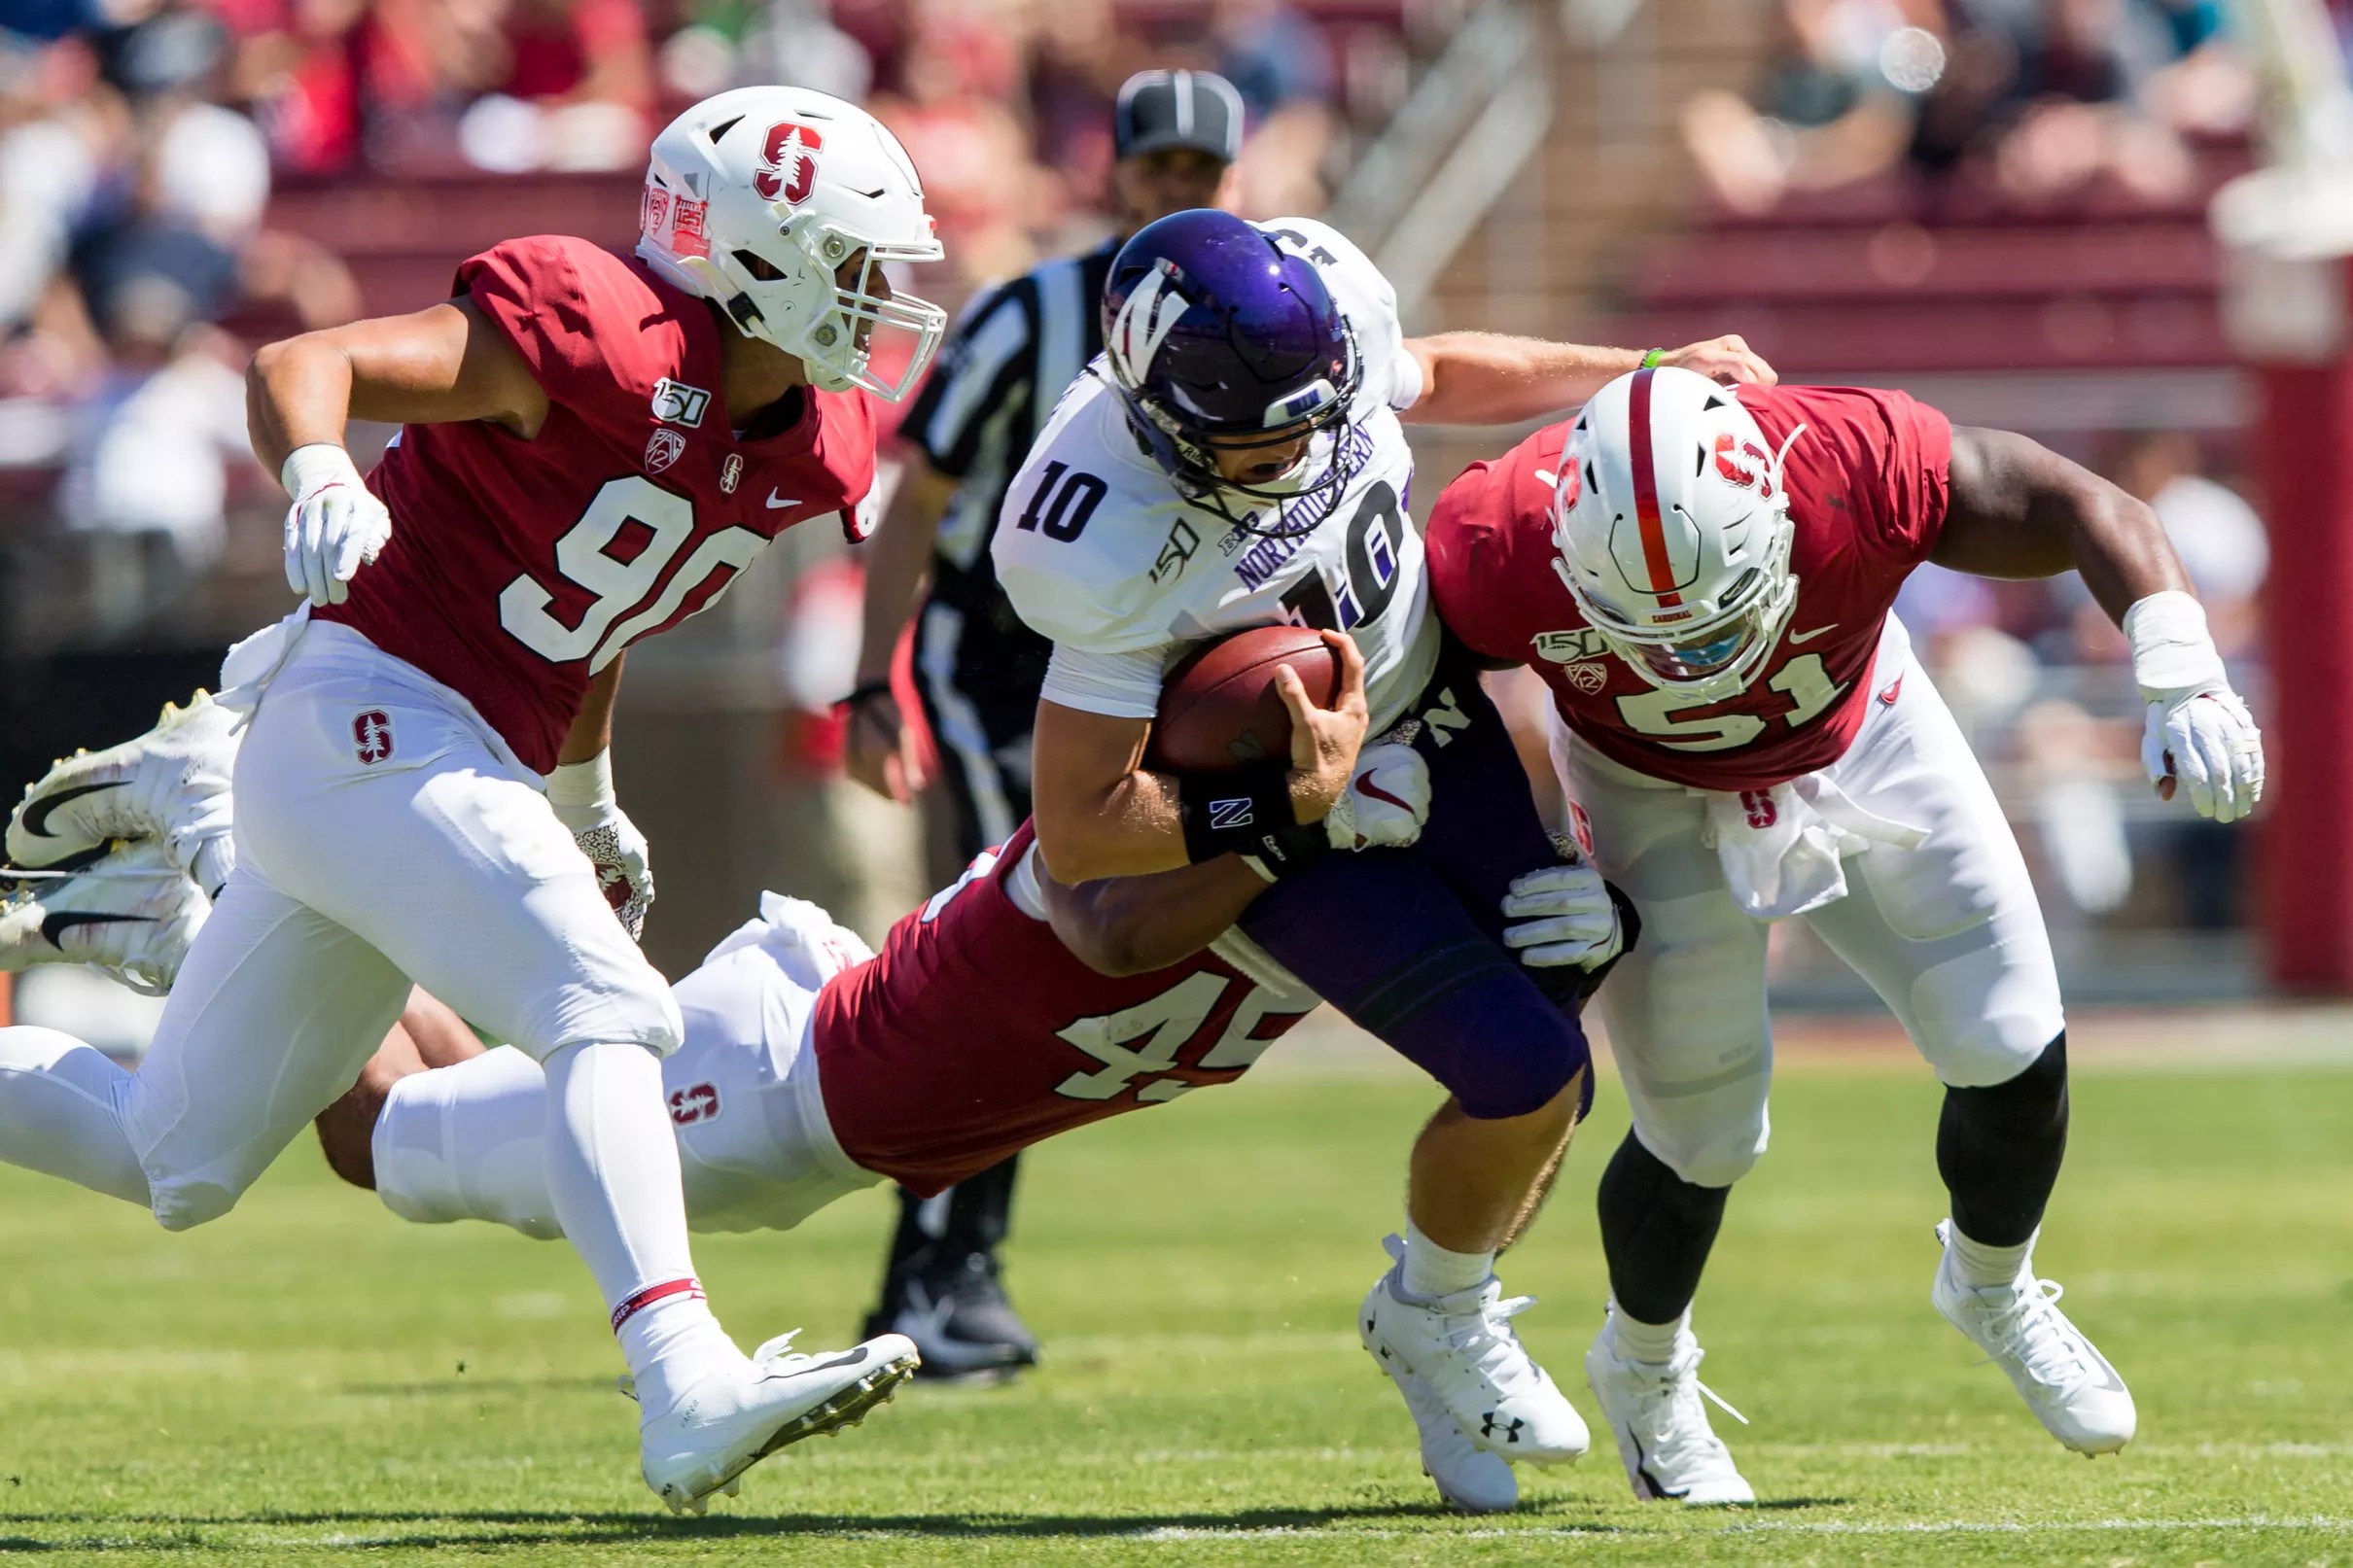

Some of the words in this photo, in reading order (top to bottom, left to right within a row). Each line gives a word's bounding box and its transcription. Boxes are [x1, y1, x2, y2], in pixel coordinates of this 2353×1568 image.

[754, 122, 825, 206] S
[654, 378, 711, 428] 150
[648, 432, 685, 463] PAC
[648, 448, 669, 469] 12
[1017, 461, 1108, 544] 10
[499, 474, 774, 678] 90
[1148, 517, 1201, 585] 150
[1536, 628, 1610, 662] 150
[1566, 664, 1604, 682] PAC
[1578, 677, 1599, 688] 12
[1615, 652, 1849, 752] 51
[351, 708, 393, 765] S
[1210, 797, 1253, 828] N
[1054, 970, 1323, 1102] 45
[671, 1081, 720, 1125] S
